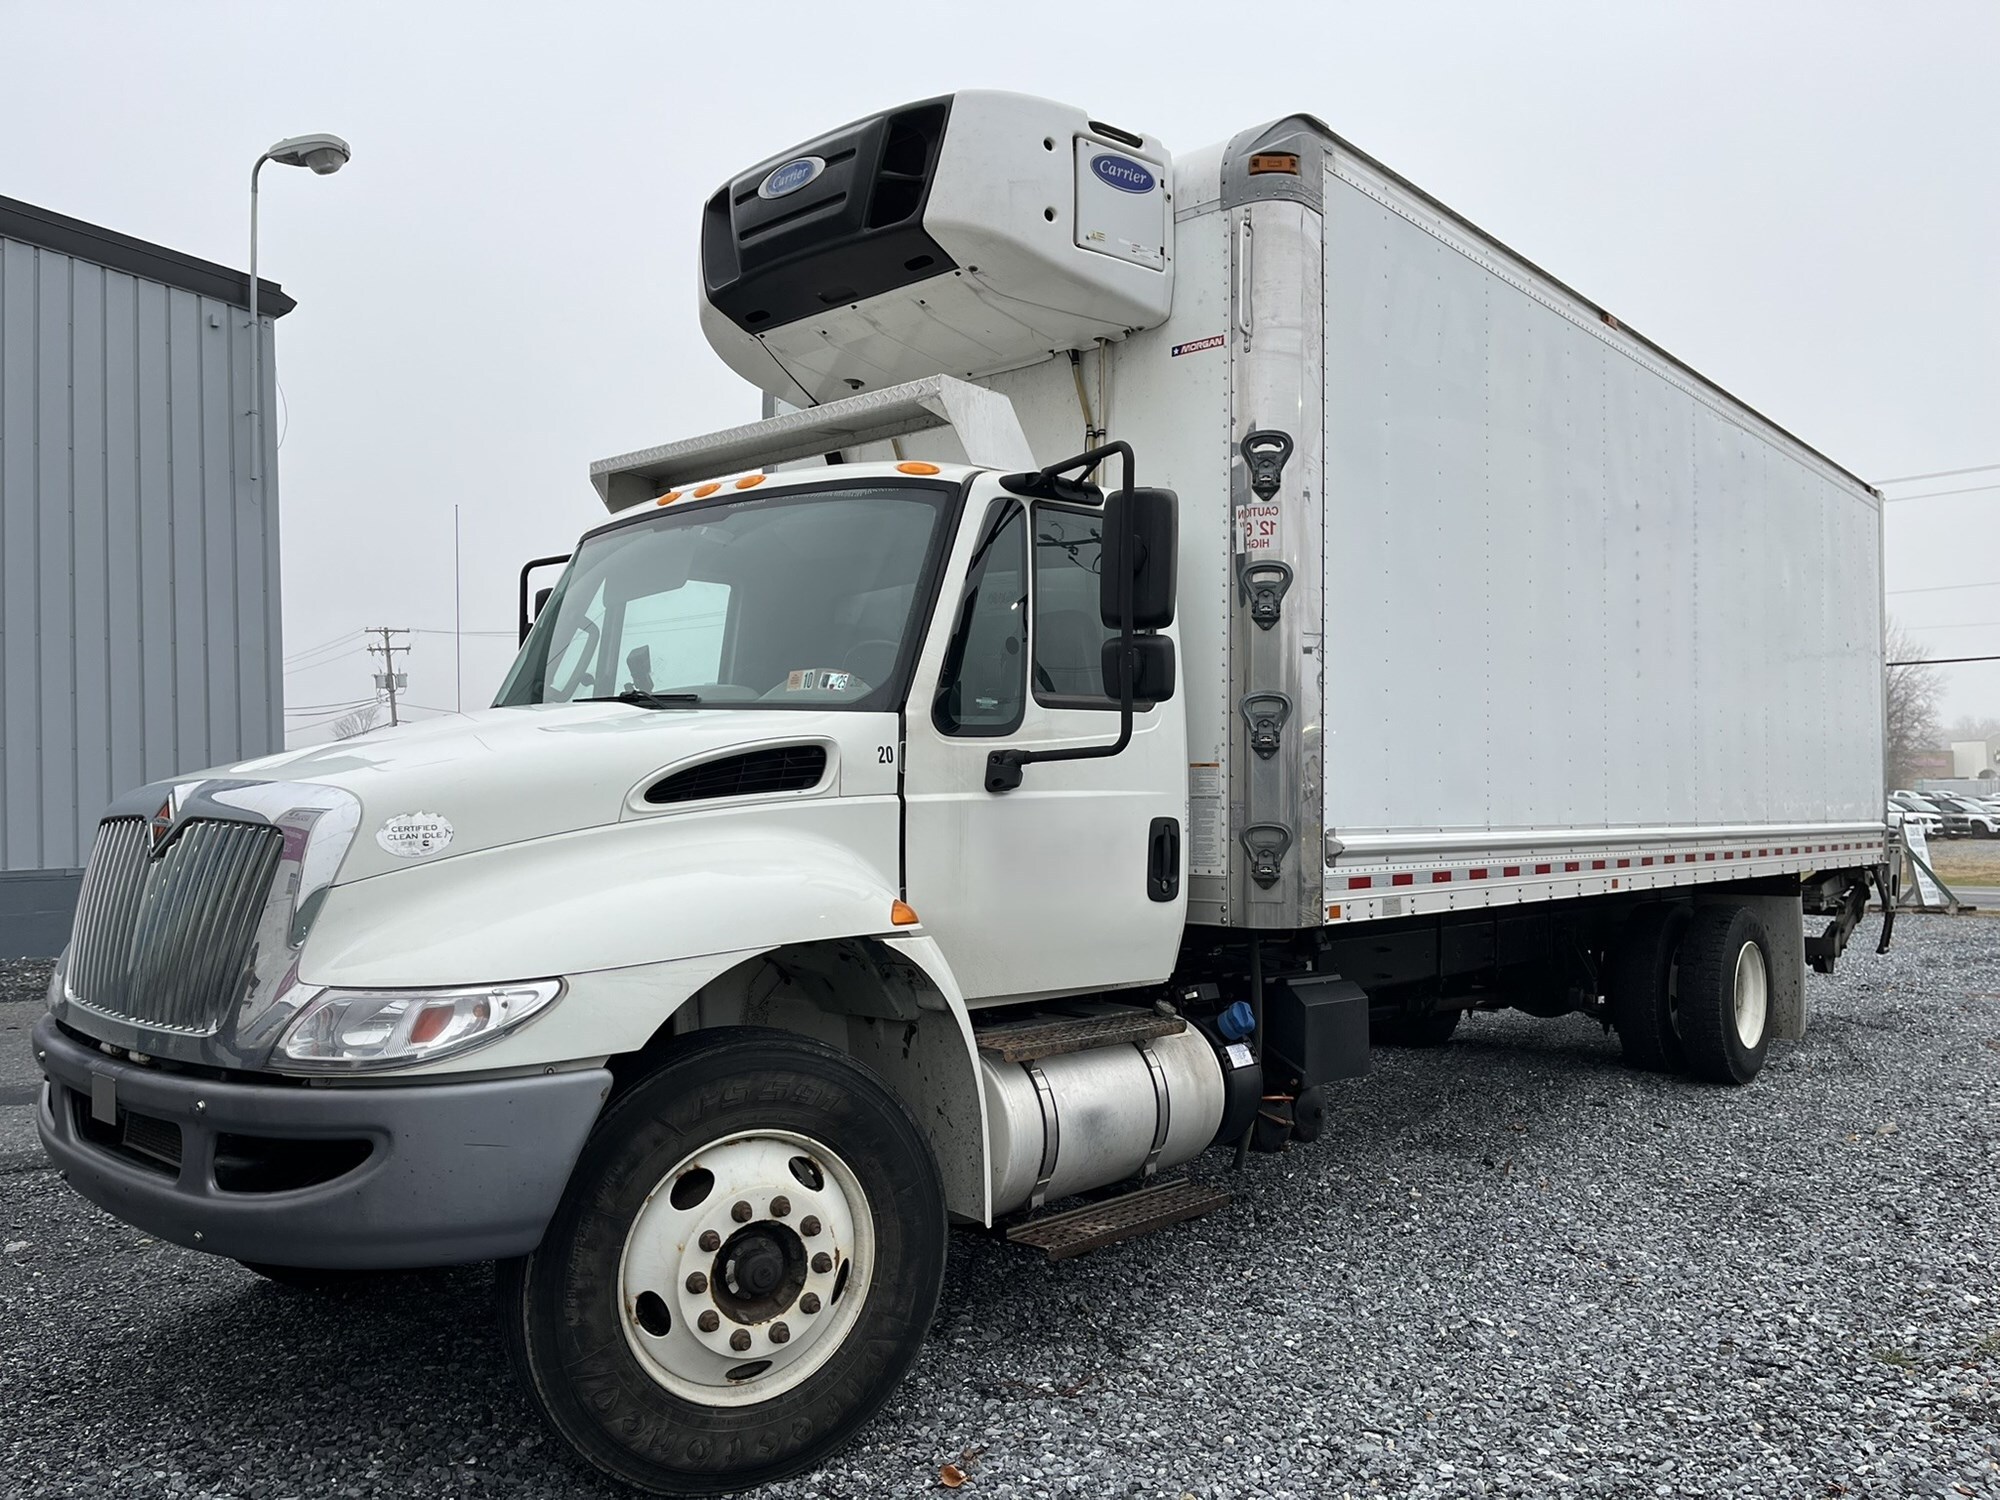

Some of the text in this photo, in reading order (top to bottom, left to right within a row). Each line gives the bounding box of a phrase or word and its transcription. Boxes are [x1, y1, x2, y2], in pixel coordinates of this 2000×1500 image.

[772, 167, 809, 190] Carrier
[1099, 159, 1148, 185] Carrier
[1180, 336, 1223, 354] MORGAN
[803, 671, 814, 689] 10
[877, 745, 894, 764] 20
[387, 833, 419, 841] CLEAN
[391, 824, 438, 833] CERTIFIED
